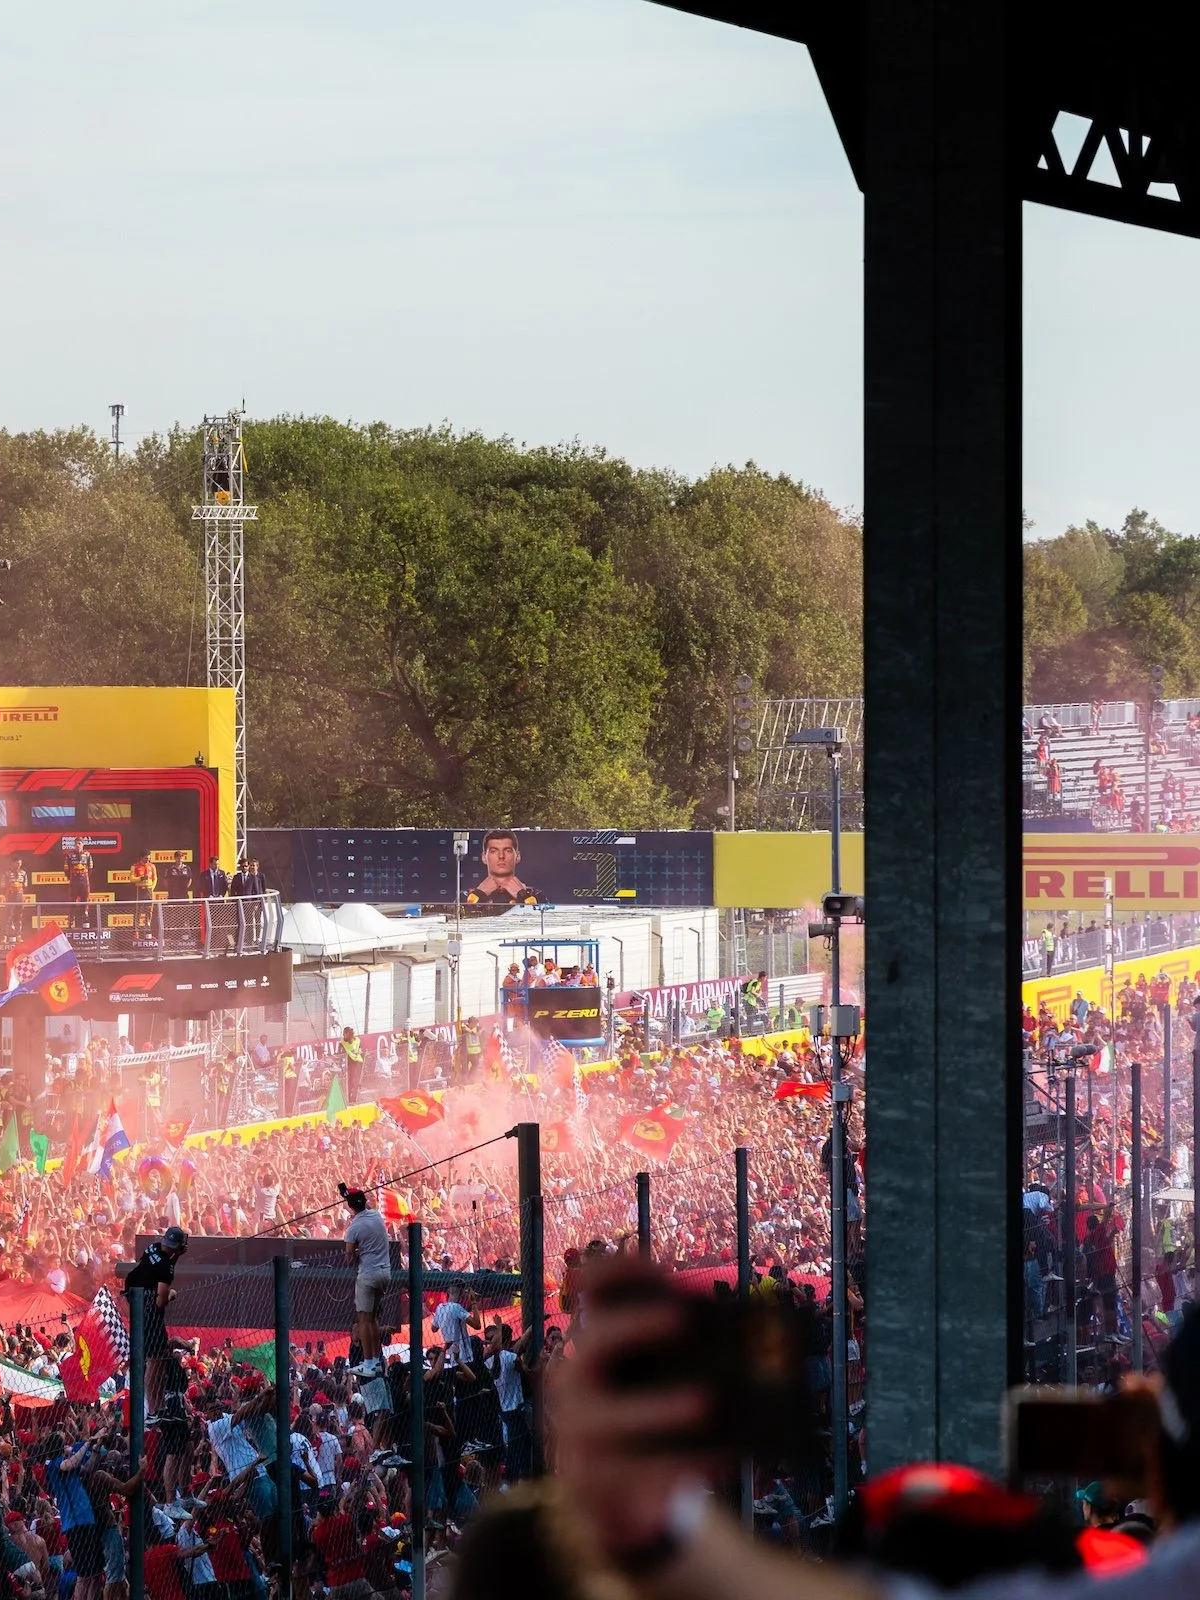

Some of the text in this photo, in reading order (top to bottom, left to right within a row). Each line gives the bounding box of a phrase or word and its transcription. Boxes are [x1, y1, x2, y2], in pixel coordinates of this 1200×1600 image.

[643, 988, 687, 1019] QATAR
[691, 979, 743, 1014] AIRWAYS
[534, 1008, 599, 1019] P ZERO
